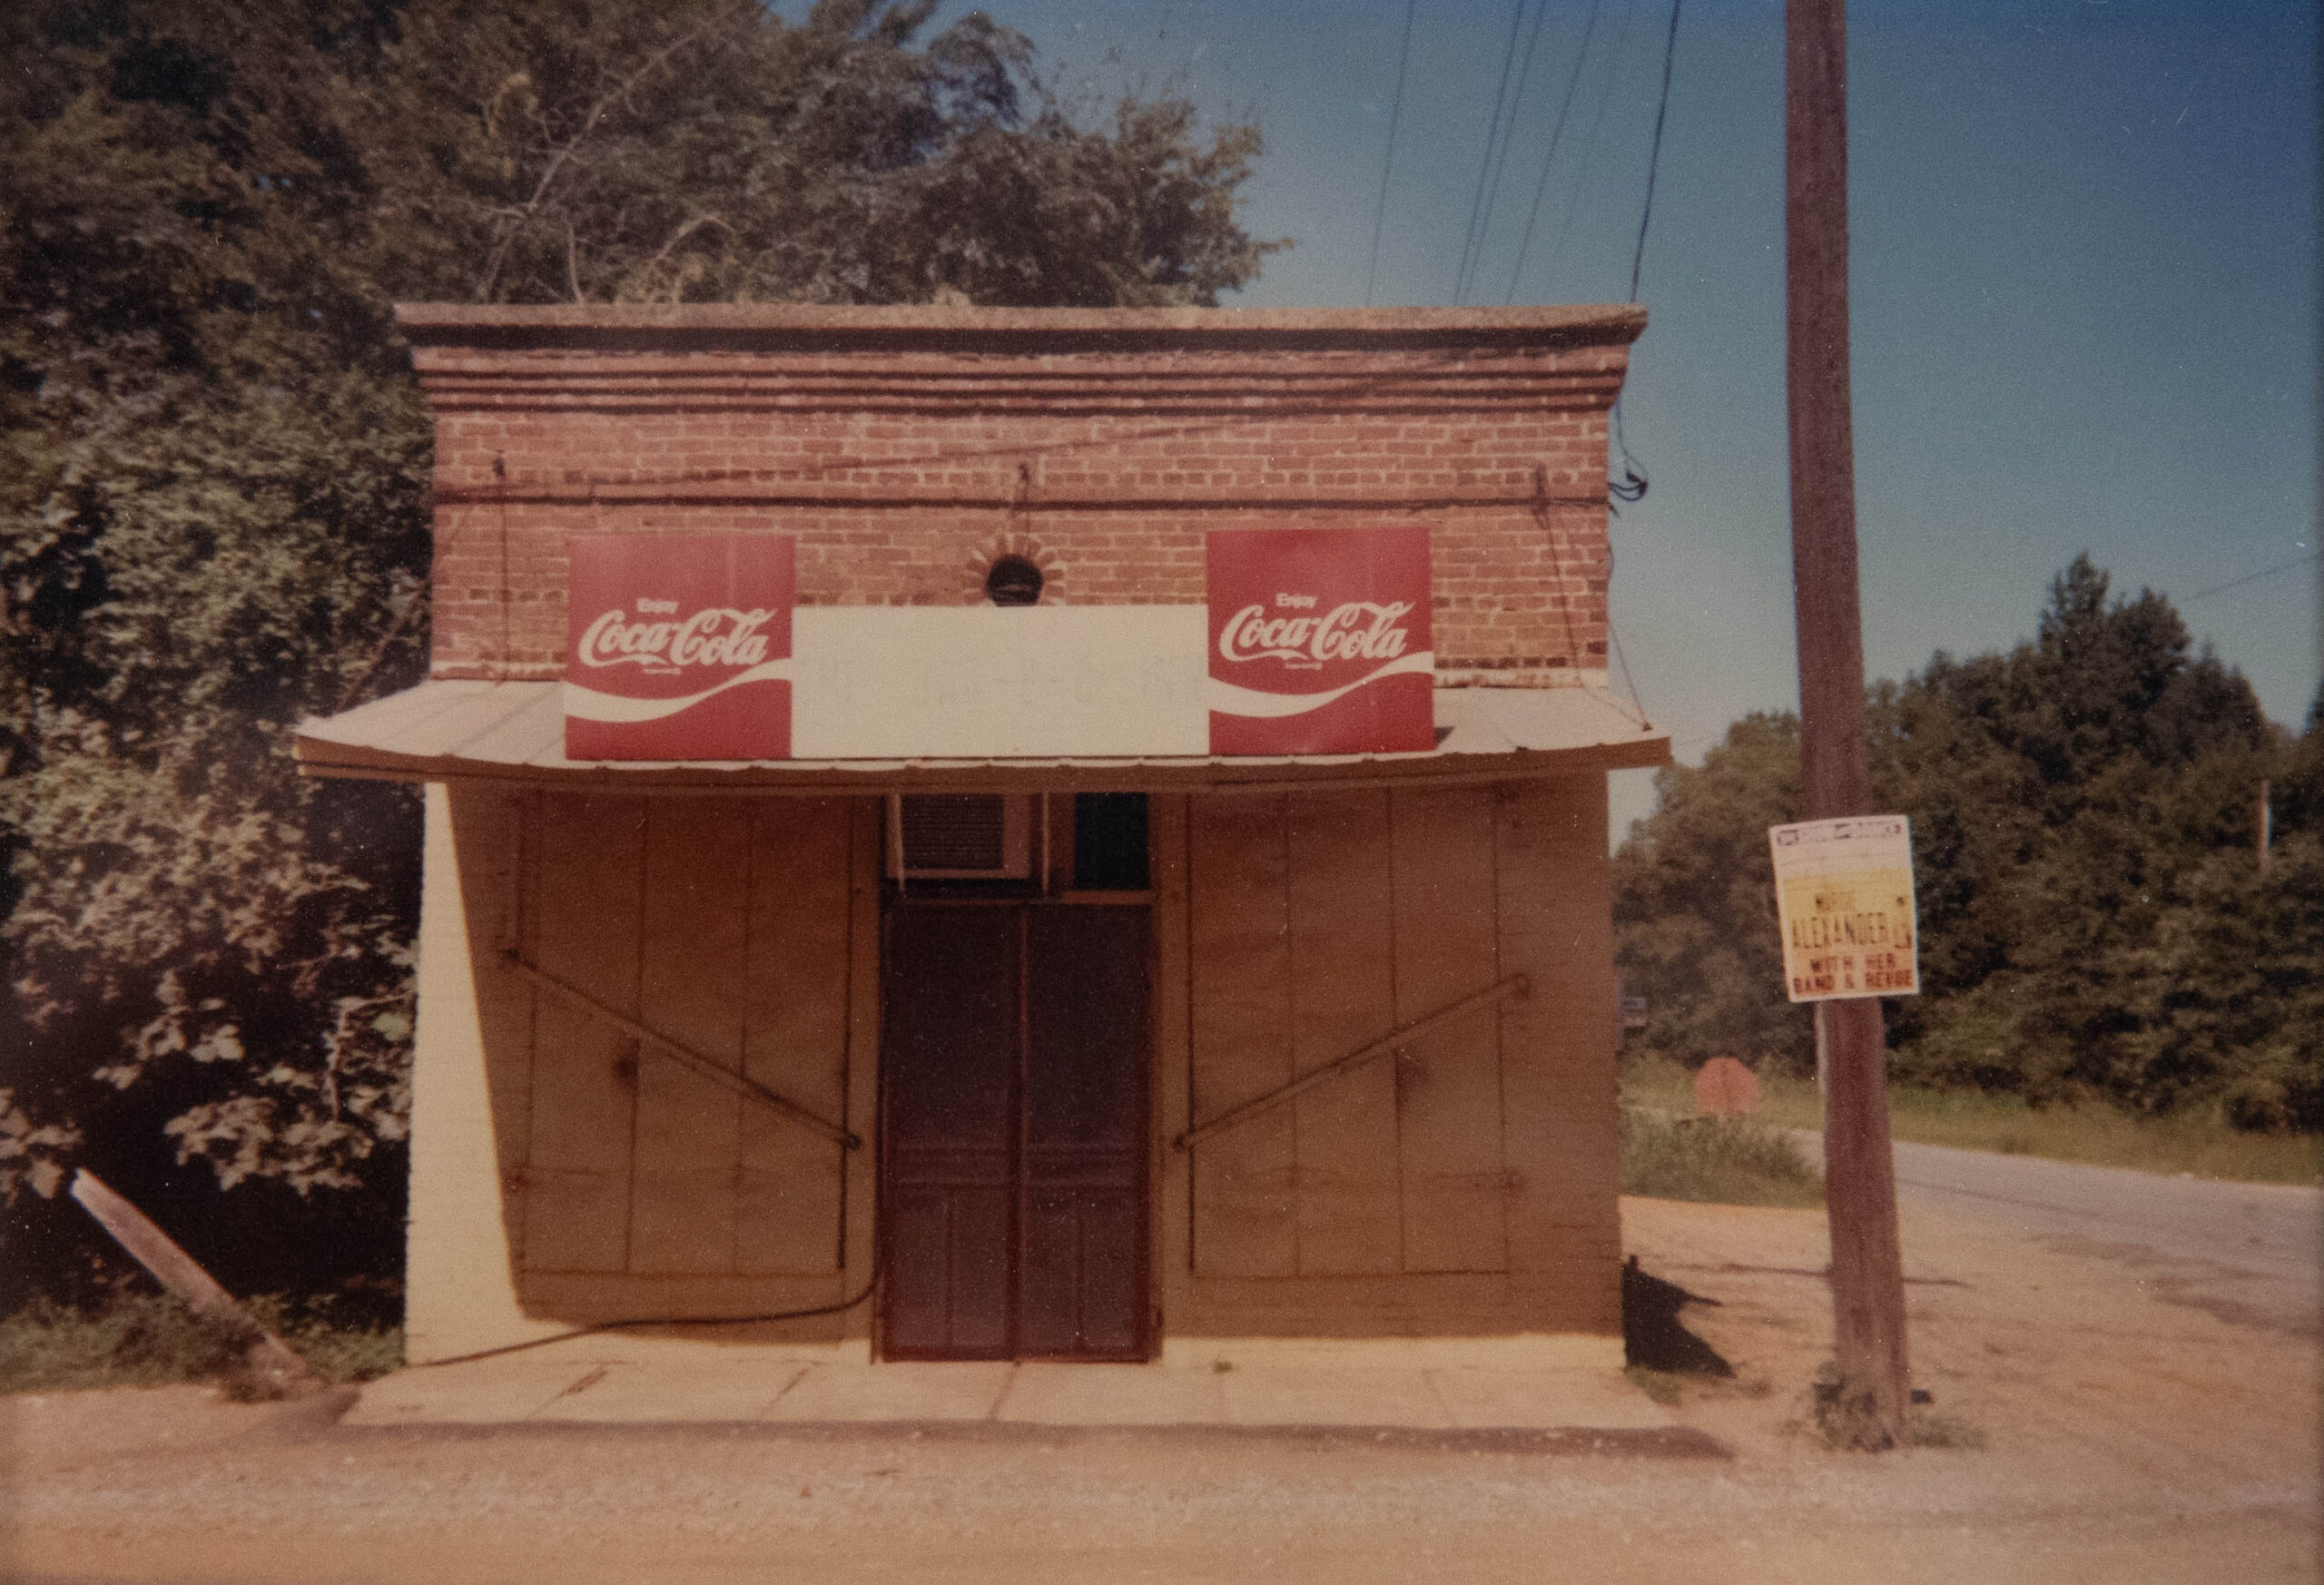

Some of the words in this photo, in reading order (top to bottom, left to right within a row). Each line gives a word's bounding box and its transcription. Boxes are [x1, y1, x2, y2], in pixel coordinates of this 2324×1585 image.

[1275, 593, 1316, 609] Enjoy
[578, 607, 778, 667] Coca-Cola
[1219, 601, 1416, 662] Coca-Cola
